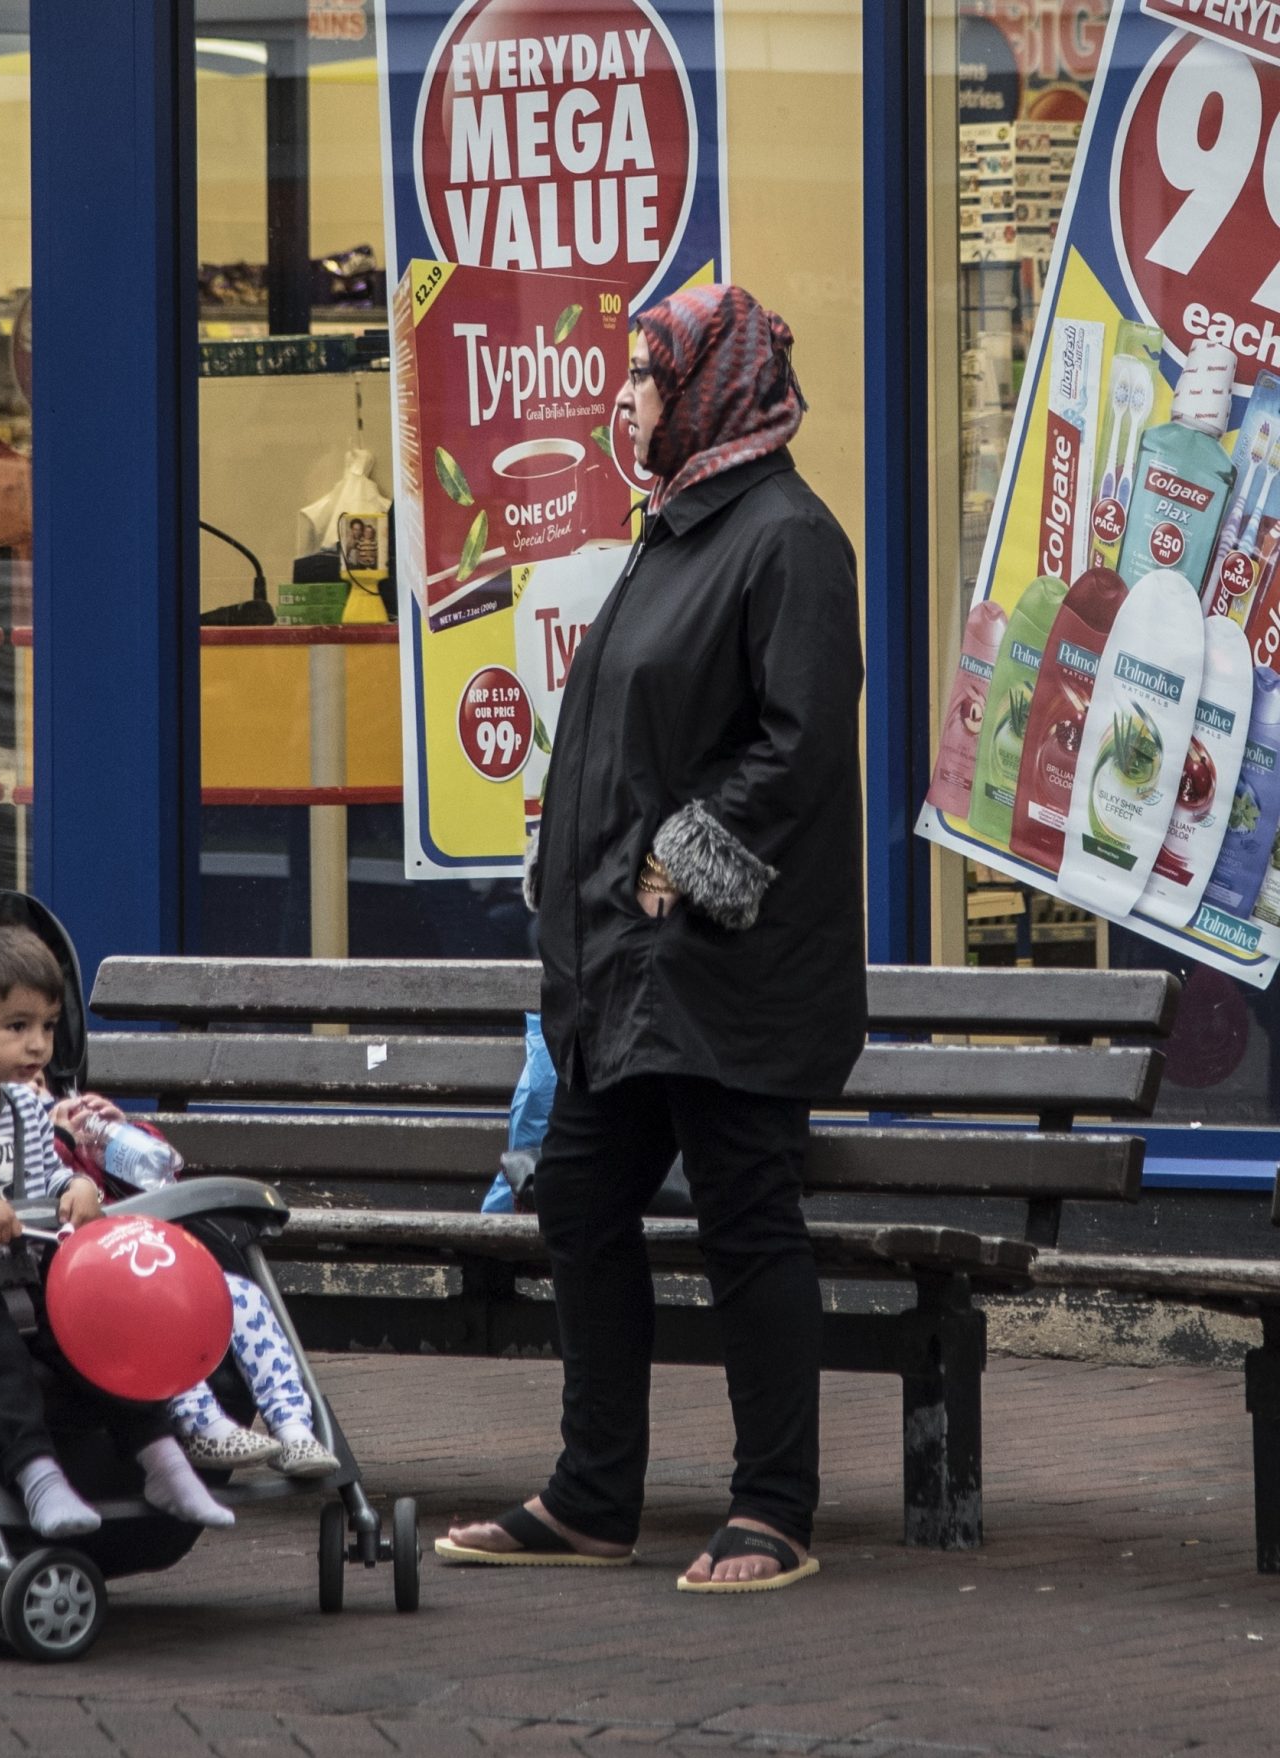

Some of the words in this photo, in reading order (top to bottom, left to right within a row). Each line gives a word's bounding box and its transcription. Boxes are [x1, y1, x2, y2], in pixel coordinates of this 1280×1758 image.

[452, 28, 651, 93] EVERYDAY
[450, 83, 655, 184] MEGA
[444, 175, 660, 271] VALUE
[415, 266, 442, 306] £2.19
[599, 293, 622, 315] 100
[1148, 471, 1207, 505] Colgate
[505, 504, 542, 526] ONE
[545, 490, 577, 520] CUP
[1043, 435, 1072, 578] Colgate
[1104, 505, 1117, 521] 2
[1155, 499, 1193, 526] Plax
[513, 529, 546, 551] Special
[547, 518, 573, 543] Blend
[1094, 516, 1121, 536] PACK
[1153, 530, 1181, 553] 250
[1158, 548, 1171, 558] ml
[1234, 558, 1245, 575] 3
[1223, 570, 1250, 589] PACK
[440, 614, 452, 625] NET
[481, 600, 498, 613] (200g)
[1059, 642, 1099, 674] Palmol
[1062, 668, 1093, 684] NATURA
[1117, 655, 1180, 699] Palmolive
[469, 689, 489, 703] RRP
[492, 687, 520, 702] £1.99
[1122, 683, 1169, 708] NATURALS
[475, 706, 492, 718] OUR
[494, 706, 515, 718] PRICE
[1046, 763, 1074, 780] BRILLIAN
[1098, 789, 1121, 803] SILKY
[1120, 799, 1143, 816] SHINE
[1105, 802, 1133, 821] EFFECT
[1195, 906, 1258, 951] Palmolive
